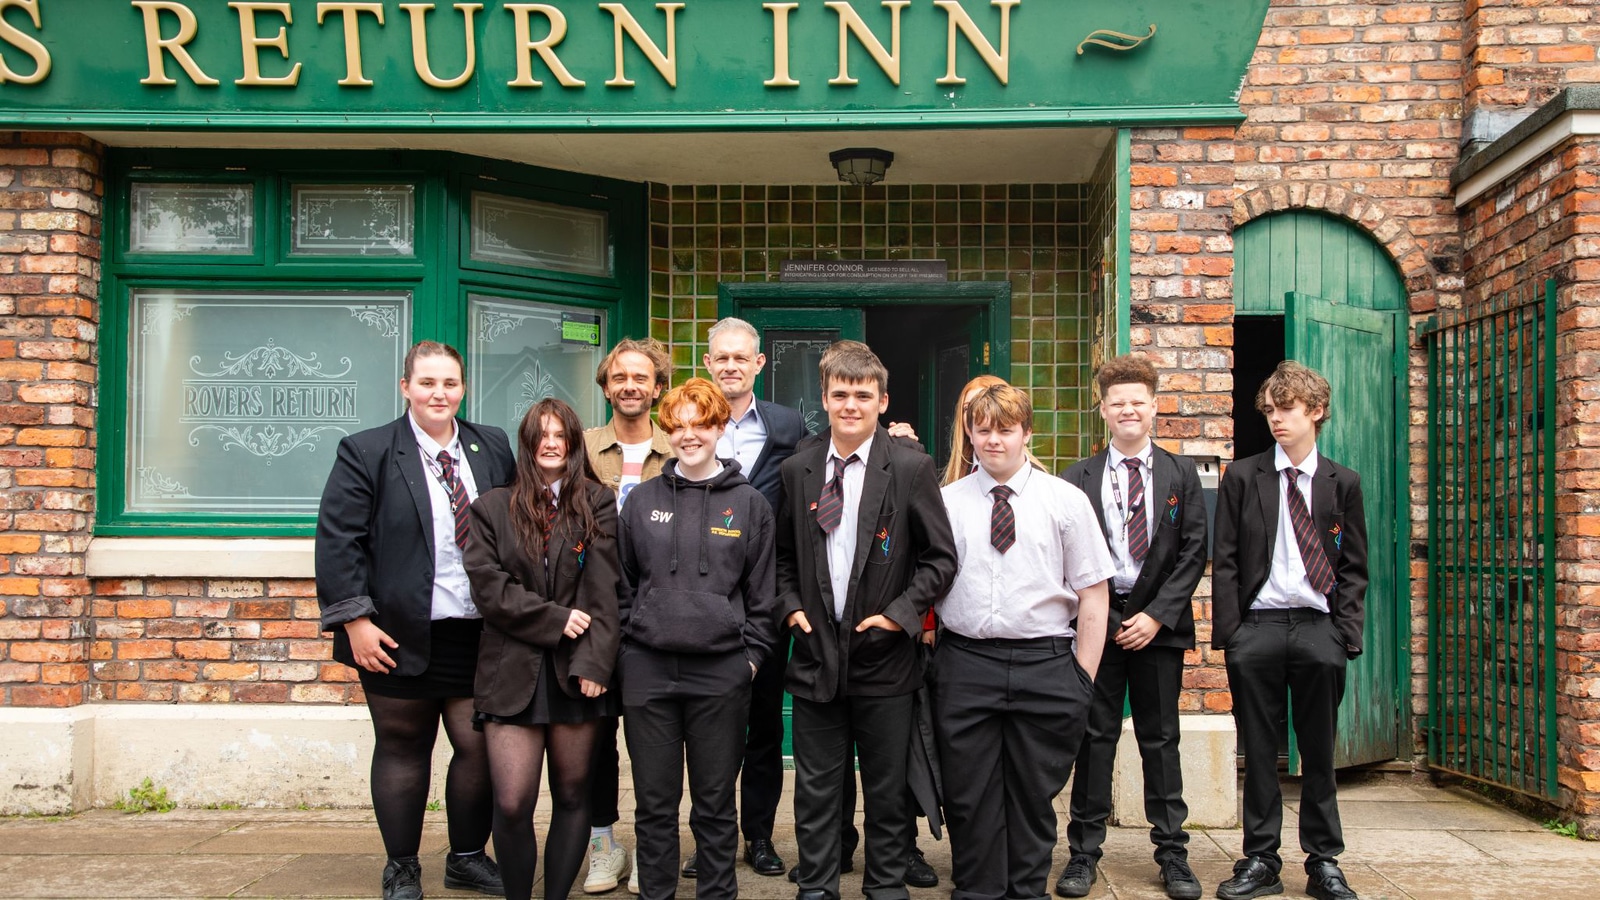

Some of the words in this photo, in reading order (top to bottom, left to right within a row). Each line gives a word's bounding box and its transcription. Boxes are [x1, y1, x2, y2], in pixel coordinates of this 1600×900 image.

[131, 1, 685, 88] RETURN
[762, 0, 1021, 86] INN
[826, 264, 864, 272] CONNOR
[182, 385, 264, 417] ROVERS
[270, 386, 357, 417] RETURN
[650, 509, 674, 523] SW
